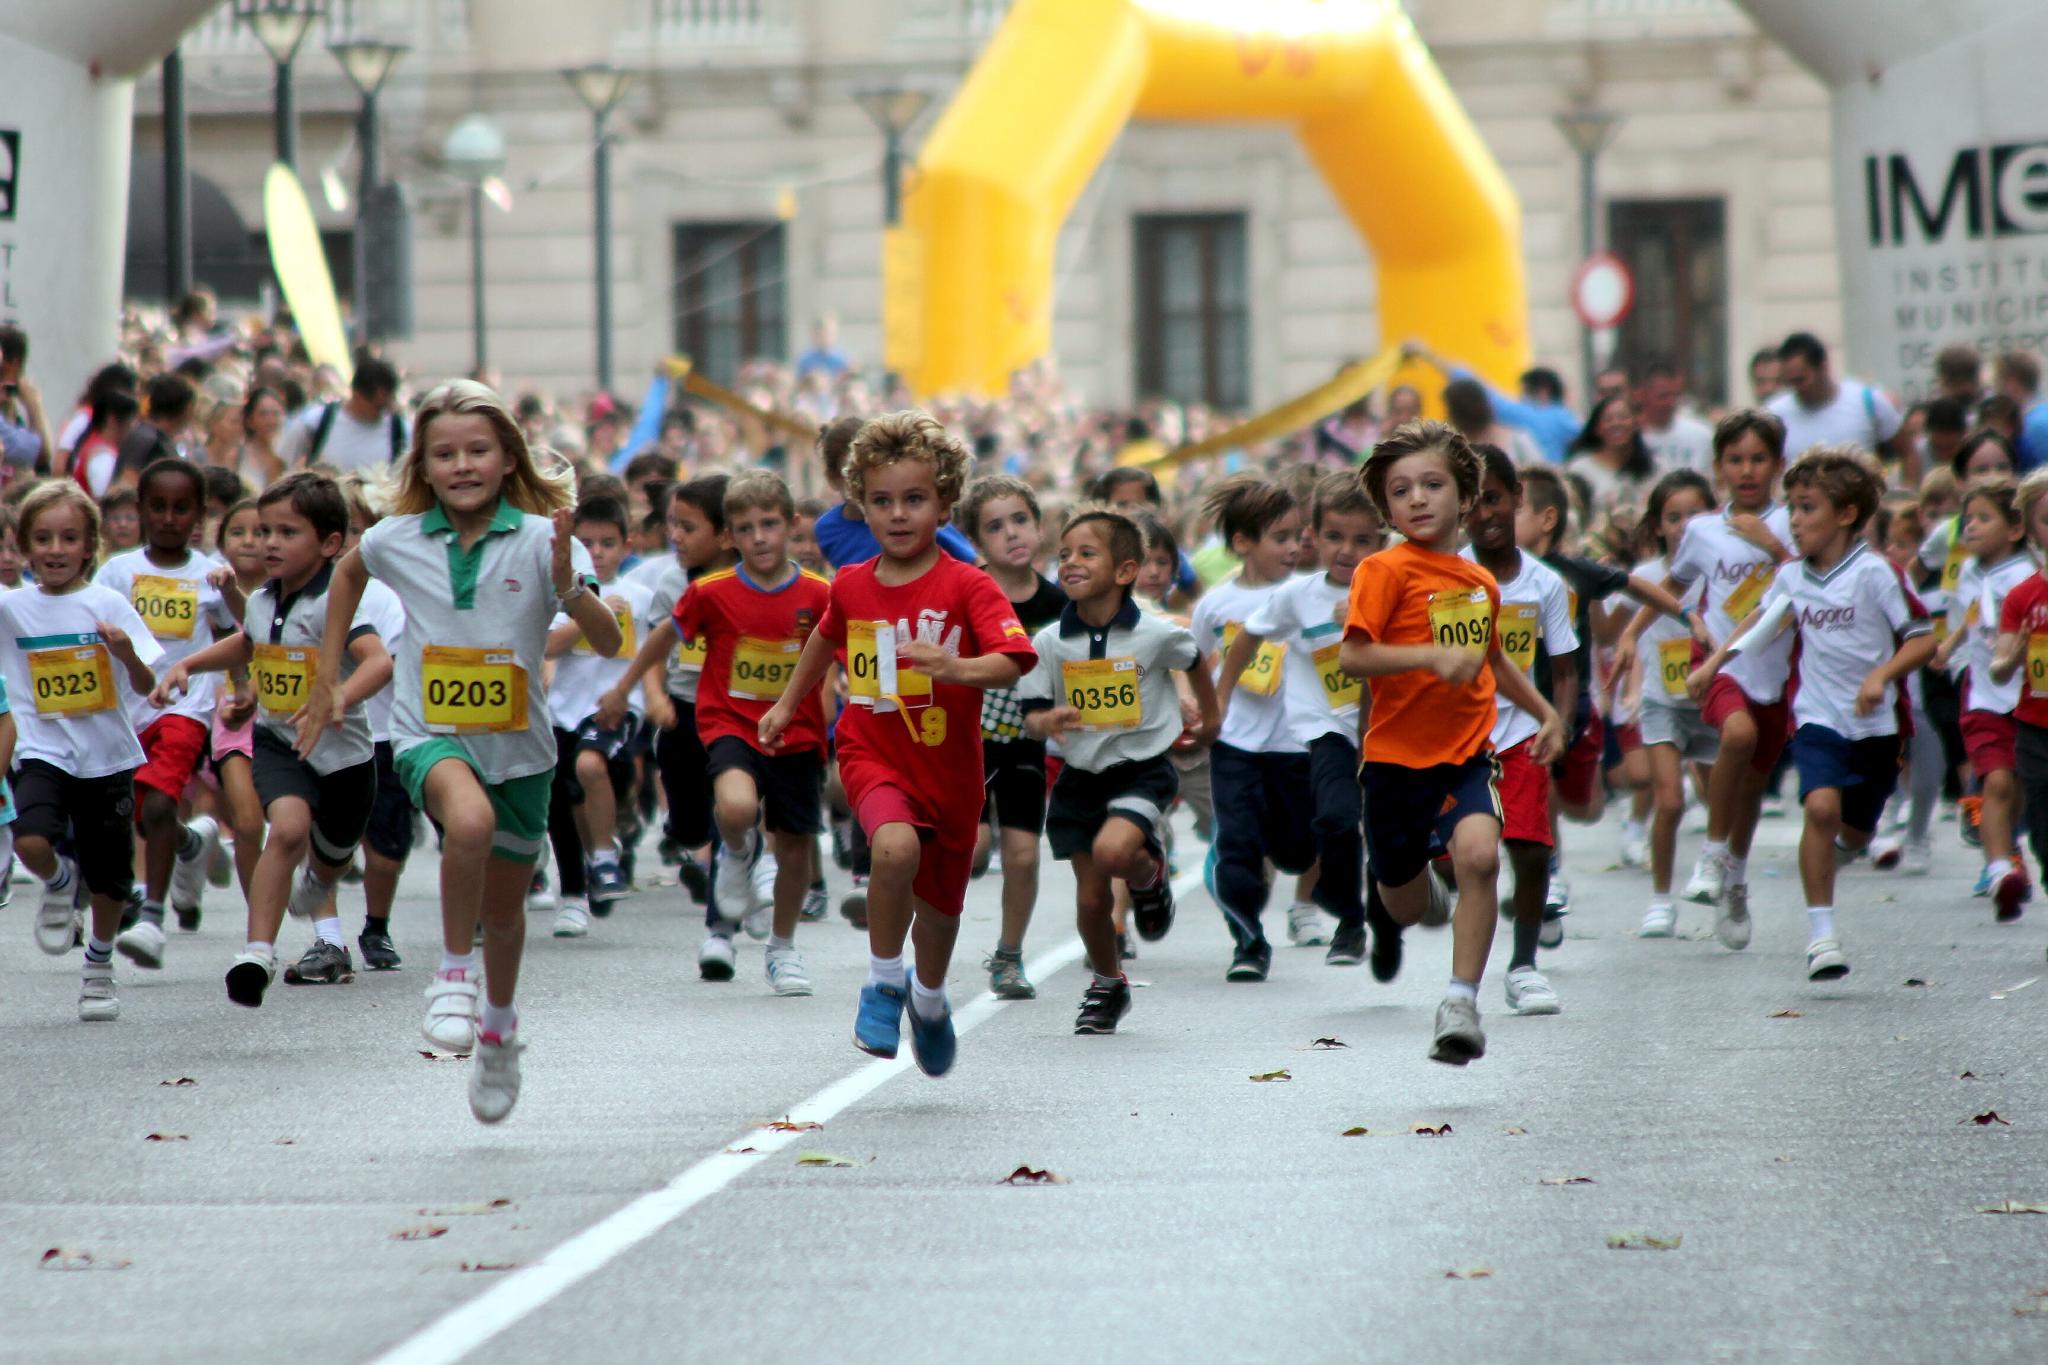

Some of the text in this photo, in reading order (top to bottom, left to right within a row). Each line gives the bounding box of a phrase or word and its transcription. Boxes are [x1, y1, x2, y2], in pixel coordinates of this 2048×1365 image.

[1714, 558, 1760, 585] Ago
[135, 597, 192, 620] 0063
[1800, 605, 1855, 630] Agora
[1440, 616, 1491, 648] 0092
[1499, 631, 1531, 653] 62
[737, 661, 797, 683] 0497
[854, 652, 879, 680] 01
[1665, 662, 1691, 682] 00
[37, 671, 97, 699] 0323
[428, 679, 506, 707] 0203
[1324, 668, 1362, 693] 02
[1071, 683, 1135, 711] 0356
[920, 706, 947, 747] 9
